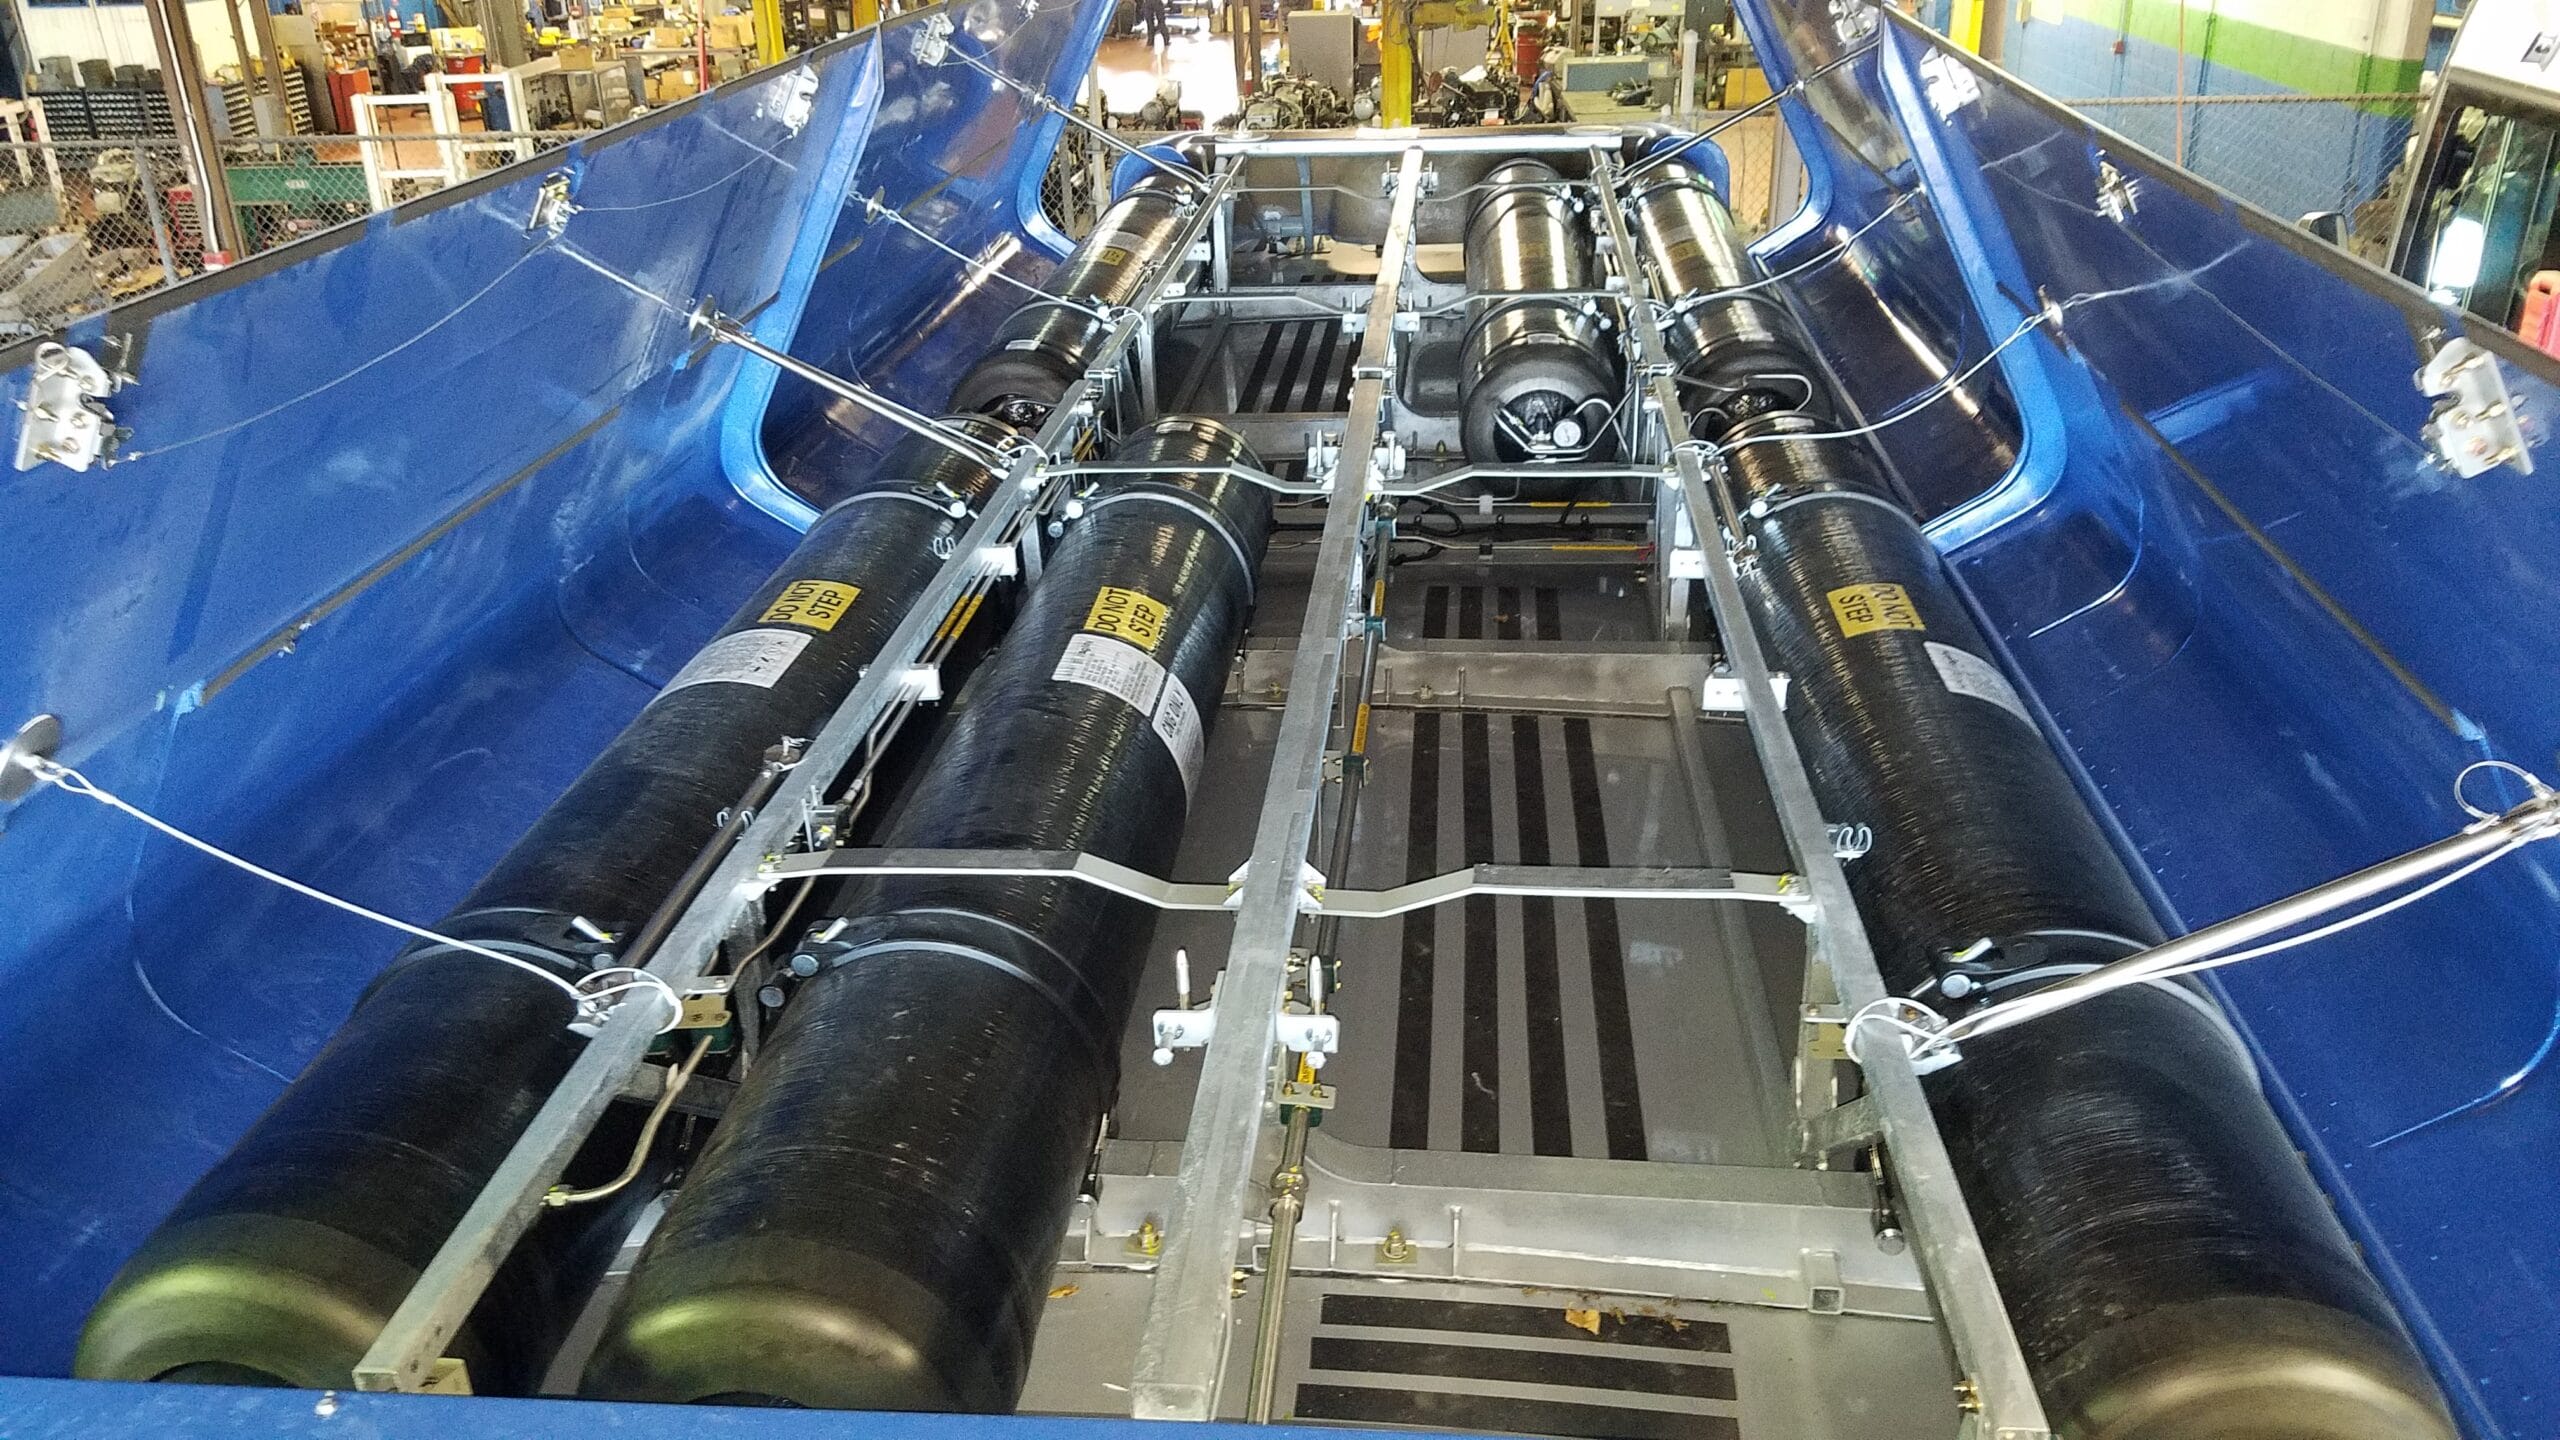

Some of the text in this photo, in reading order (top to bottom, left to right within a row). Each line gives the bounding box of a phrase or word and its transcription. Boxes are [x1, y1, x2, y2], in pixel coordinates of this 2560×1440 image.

[768, 582, 820, 621] DO NOT
[806, 589, 845, 619] STEP
[1093, 588, 1131, 632] DO NOT
[1128, 603, 1157, 637] STEP
[1838, 593, 1874, 623] STEP
[1869, 584, 1914, 628] DO NOT
[1162, 689, 1185, 738] CNG ONLY
